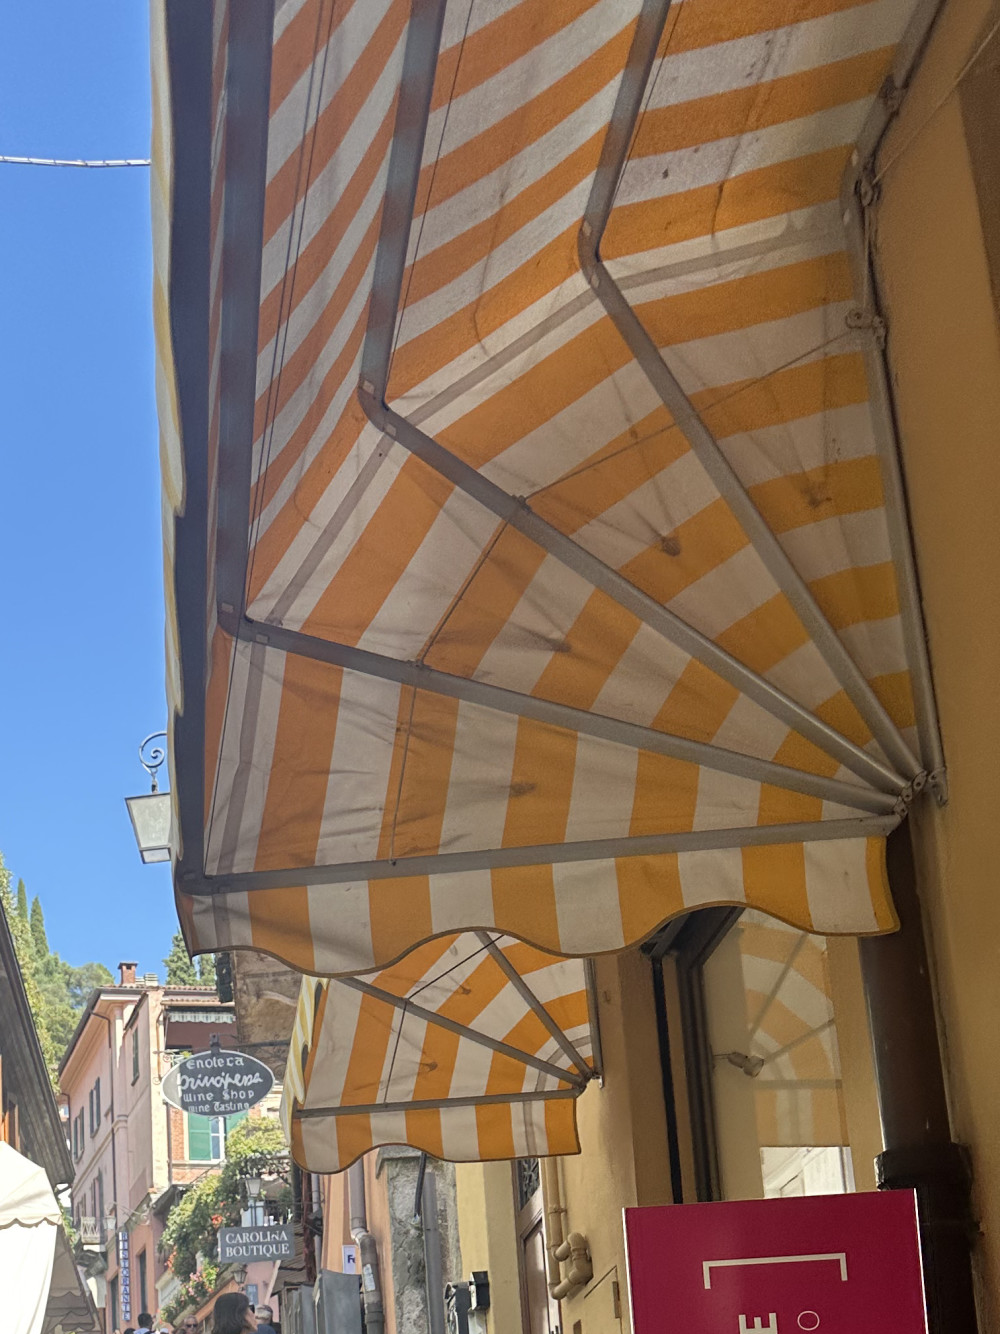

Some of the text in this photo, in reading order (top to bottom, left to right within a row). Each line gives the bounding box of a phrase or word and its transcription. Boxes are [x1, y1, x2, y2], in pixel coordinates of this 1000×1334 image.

[225, 1230, 288, 1244] CAROLINA
[225, 1243, 290, 1257] BOUTIQUE
[121, 1232, 130, 1320] RISTORANTE
